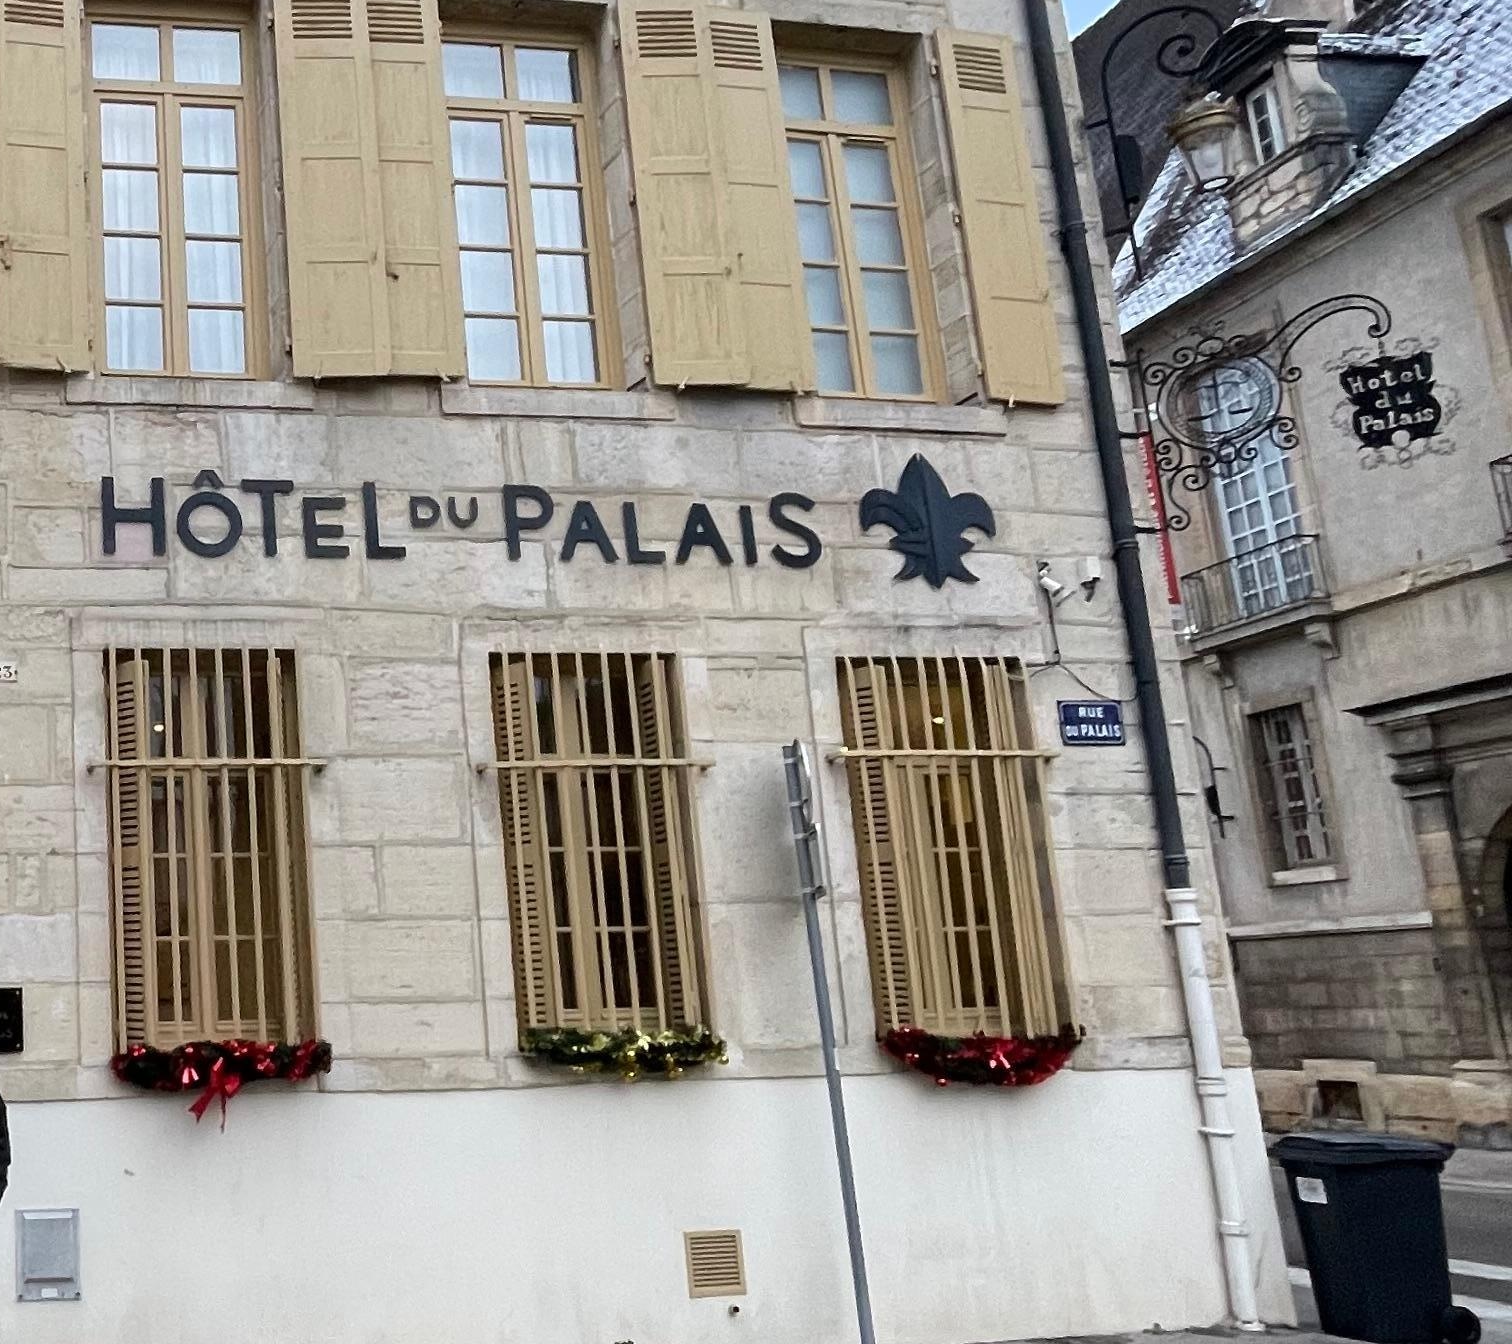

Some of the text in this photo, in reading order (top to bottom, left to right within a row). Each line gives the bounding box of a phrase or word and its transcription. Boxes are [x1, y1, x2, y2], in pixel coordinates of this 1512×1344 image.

[1346, 364, 1427, 394] Hotel
[1375, 391, 1413, 409] du
[1359, 408, 1434, 434] Palais
[409, 494, 481, 530] DU
[502, 483, 824, 568] PALAIS
[1079, 707, 1104, 718] RUE
[1081, 724, 1121, 737] PALAIS
